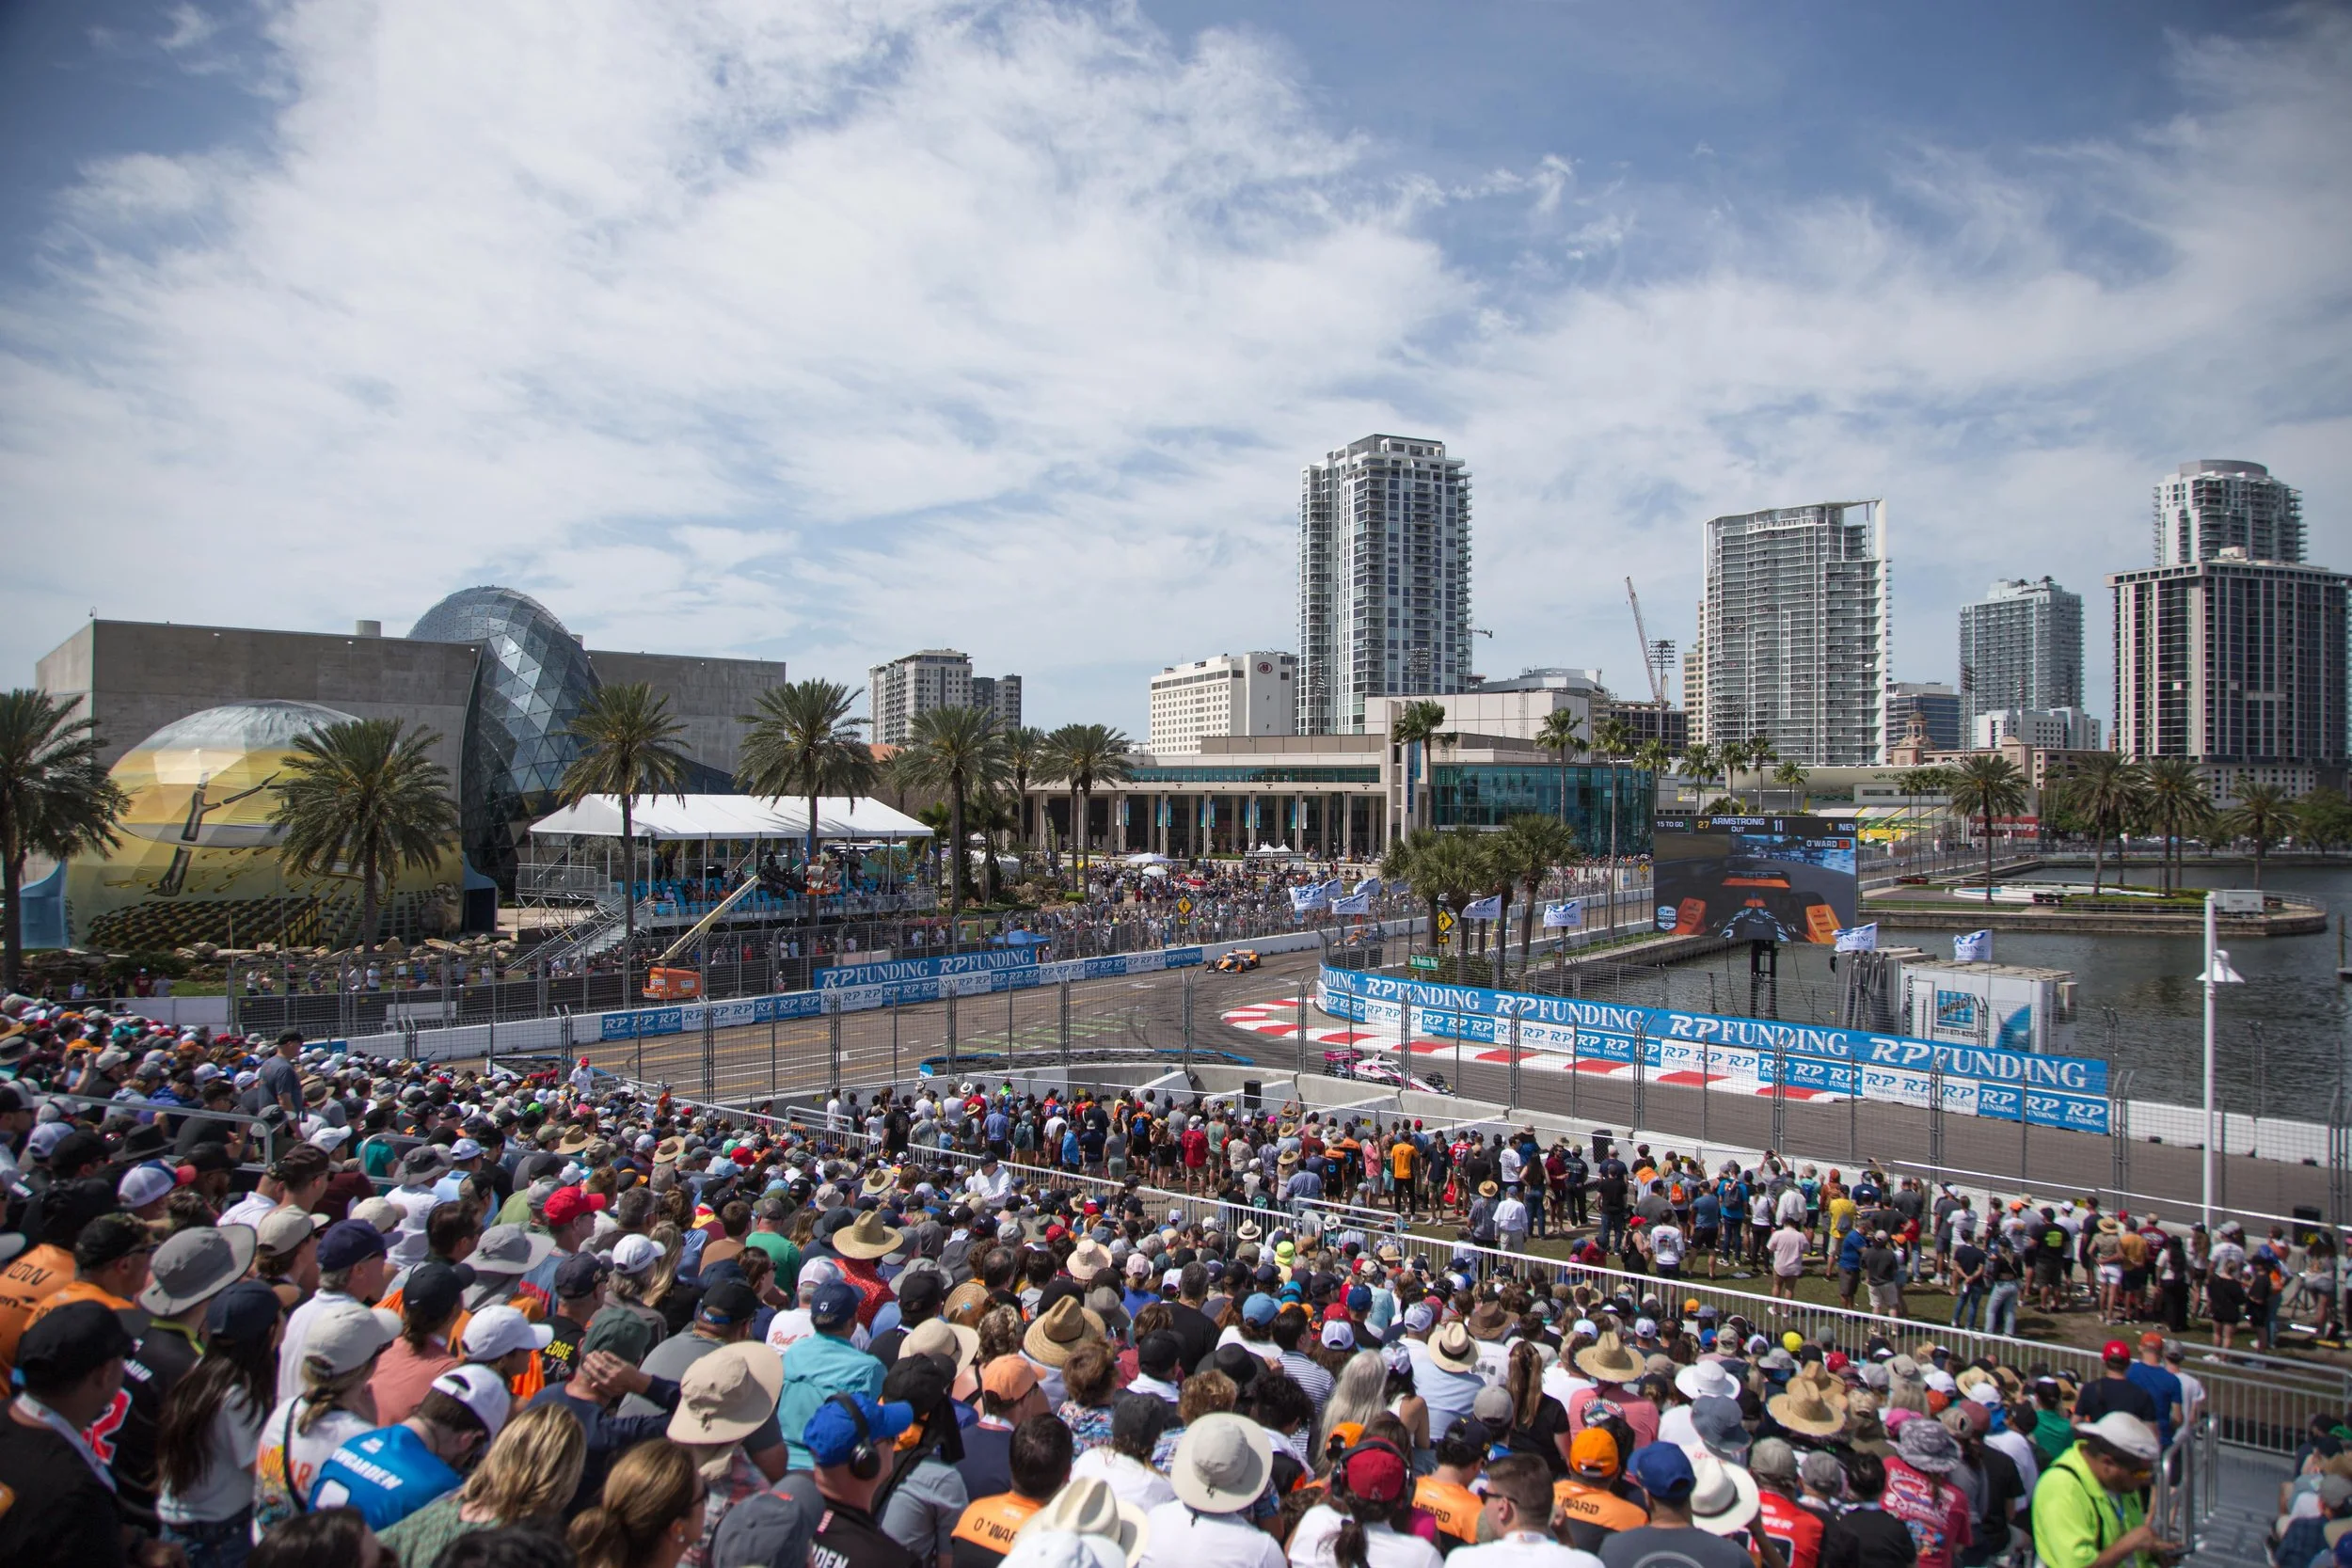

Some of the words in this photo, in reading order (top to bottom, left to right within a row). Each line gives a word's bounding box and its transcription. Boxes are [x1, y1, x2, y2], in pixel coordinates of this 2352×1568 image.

[1697, 820, 1709, 829] 27
[1711, 817, 1765, 826] ARMSTRONG
[1774, 819, 1783, 832] 11
[1827, 823, 1833, 832] 1
[939, 957, 967, 974] RP
[969, 949, 1030, 971] FUNDING
[1177, 951, 1202, 961] FUNDING
[856, 960, 929, 984] FUNDING
[903, 984, 919, 994] RP
[922, 982, 938, 991] RP
[843, 992, 861, 1002] RP
[864, 989, 881, 998] RP
[1365, 977, 1396, 997] RP
[1396, 981, 1481, 1010] FUNDING
[779, 1000, 798, 1010] RP
[801, 997, 820, 1007] RP
[1939, 995, 1973, 1018] IMPACT
[733, 1004, 753, 1015] RP
[1367, 1004, 1382, 1015] RP
[1384, 1006, 1401, 1018] RP
[1494, 993, 1537, 1016] RP
[1538, 999, 1645, 1032] FUNDING
[658, 1011, 680, 1023] RP
[1423, 1014, 1444, 1025] RP
[1447, 1017, 1468, 1028] RP
[604, 1018, 628, 1029] RP
[659, 1022, 680, 1030] FUNDING
[1422, 1023, 1444, 1032] FUNDING
[1471, 1020, 1493, 1032] RP
[1523, 1026, 1546, 1038] RP
[1549, 1030, 1573, 1042] RP
[1669, 1014, 1720, 1039] RP
[1721, 1021, 1849, 1055] FUNDING
[1577, 1034, 1601, 1047] RP
[1604, 1037, 1629, 1051] RP
[1576, 1045, 1601, 1054] FUNDING
[1603, 1050, 1629, 1058] FUNDING
[1664, 1046, 1690, 1058] RP
[1728, 1054, 1756, 1067] RP
[1868, 1037, 1931, 1065] RP
[1931, 1045, 2088, 1088] FUNDING
[1794, 1062, 1824, 1077] RP
[1829, 1068, 1860, 1082] RP
[1793, 1075, 1824, 1085] FUNDING
[1866, 1072, 1896, 1086] RP
[1942, 1084, 1975, 1099] RP
[1981, 1088, 2017, 1105] RP
[1979, 1103, 2017, 1114] FUNDING
[2026, 1095, 2060, 1111] RP
[2066, 1101, 2106, 1118] RP
[2065, 1116, 2105, 1128] FUNDING
[544, 1339, 574, 1362] EDGE
